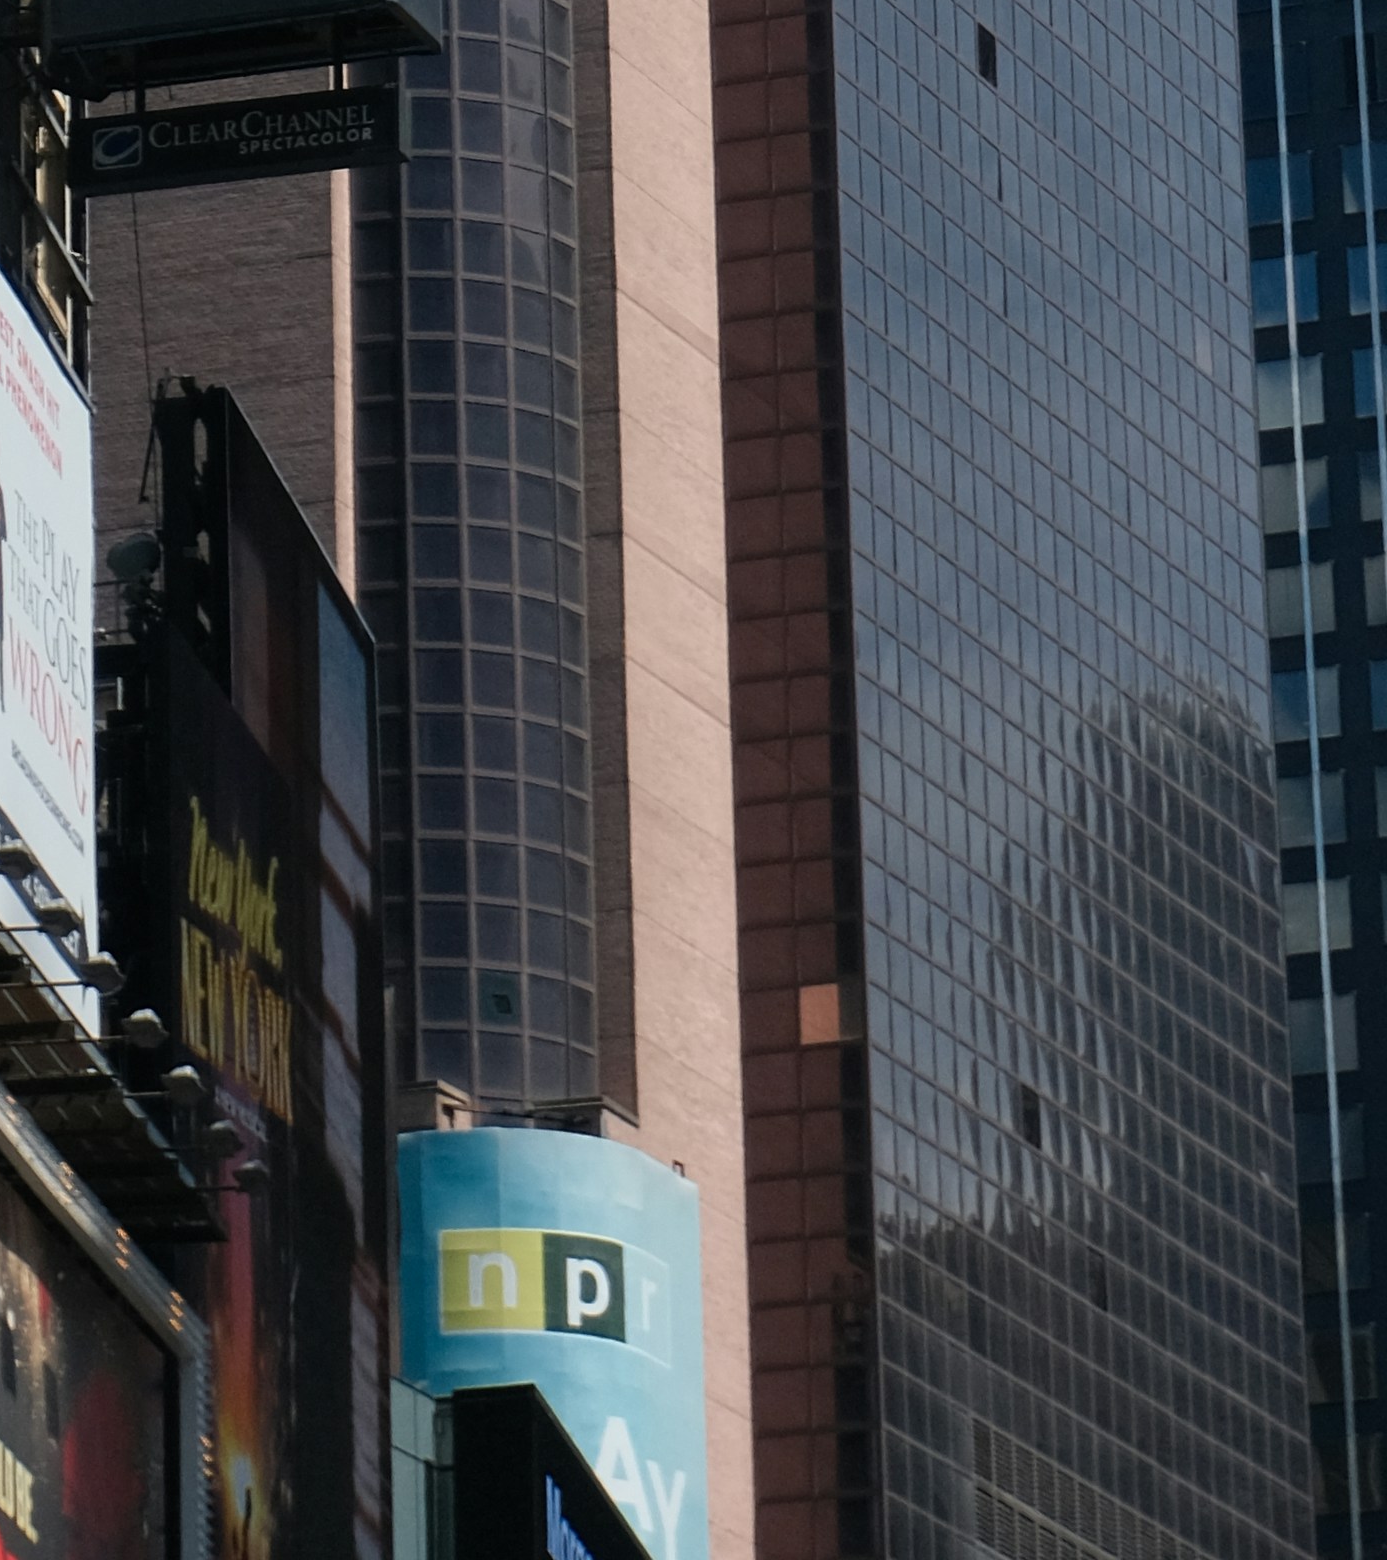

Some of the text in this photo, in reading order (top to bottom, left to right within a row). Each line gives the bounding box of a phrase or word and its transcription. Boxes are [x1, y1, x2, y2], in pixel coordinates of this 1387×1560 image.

[238, 126, 374, 156] SPECTACOLOR
[8, 543, 41, 631] THAT
[43, 597, 88, 710] GOES
[14, 489, 80, 625] THE PLAY
[7, 614, 89, 817] WRONG
[181, 916, 293, 1128] NEW YORK
[467, 1251, 657, 1332] npr
